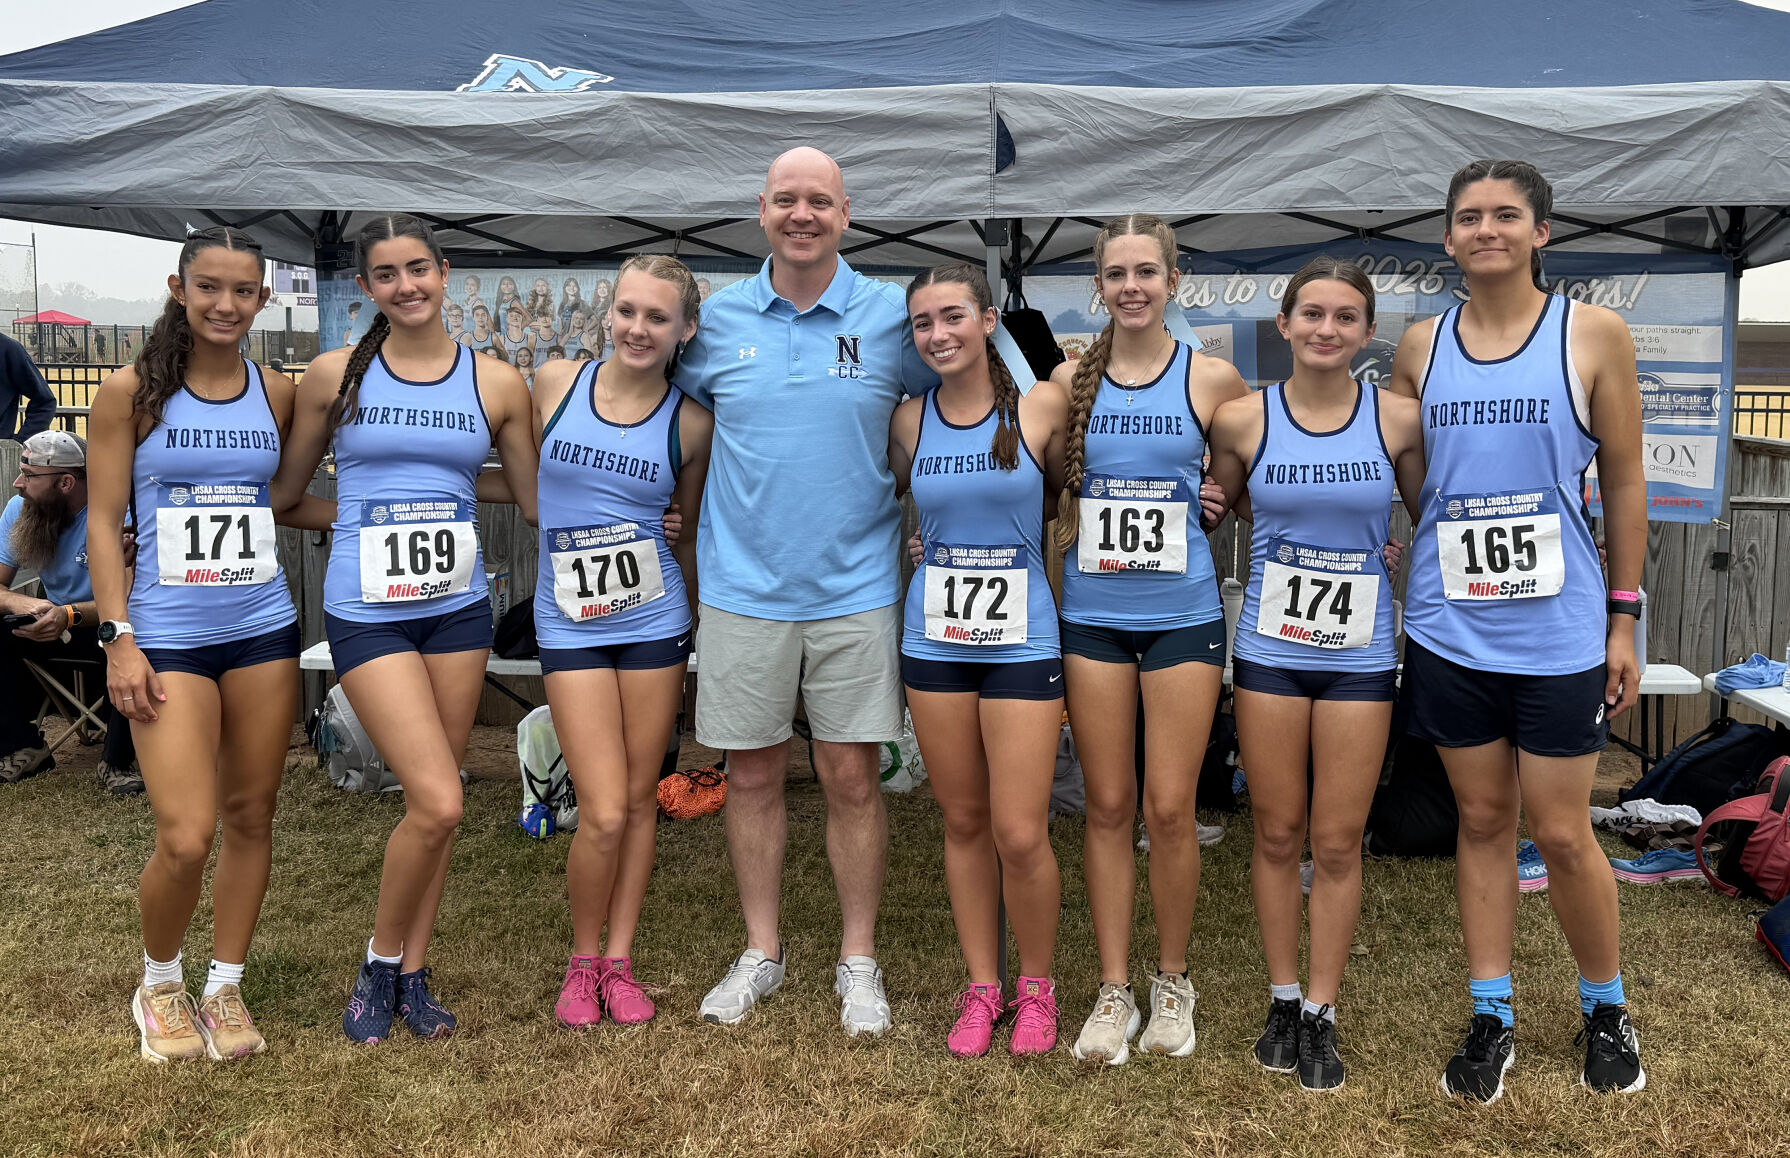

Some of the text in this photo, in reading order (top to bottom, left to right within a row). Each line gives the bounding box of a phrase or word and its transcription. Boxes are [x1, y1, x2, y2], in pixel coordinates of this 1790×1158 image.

[1223, 269, 1257, 305] to
[1646, 326, 1668, 335] paths
[835, 334, 862, 366] N
[1642, 345, 1668, 355] Family
[1672, 393, 1708, 403] Center
[354, 406, 476, 434] NORTHSHORE
[1429, 398, 1550, 430] NORTHSHORE
[165, 428, 278, 452] NORTHSHORE
[550, 439, 660, 483] NORTHSHORE
[1264, 461, 1382, 485] NORTHSHORE
[1649, 464, 1697, 478] aesthetics
[191, 485, 259, 495] LHSAA CROSS COUNTRY
[1106, 478, 1178, 490] LHSAA CROSS COUNTRY
[195, 495, 256, 504] CHAMPIONSHIPS
[1109, 488, 1172, 499] CHAMPIONSHIPS
[1464, 492, 1543, 509] LHSAA CROSS COUNTRY
[389, 502, 458, 513] LHSAA CROSS COUNTRY
[393, 510, 456, 521] CHAMPIONSHIPS
[1468, 502, 1539, 517] CHAMPIONSHIPS
[184, 514, 256, 561] 171
[570, 522, 640, 540] LHSAA CROSS COUNTRY
[1098, 507, 1165, 553] 163
[575, 531, 636, 548] CHAMPIONSHIPS
[384, 528, 456, 577] 169
[949, 548, 1017, 558] LHSAA CROSS COUNTRY
[1296, 547, 1367, 563] LHSAA CROSS COUNTRY
[1460, 524, 1538, 575] 165
[952, 557, 1013, 567] CHAMPIONSHIPS
[1299, 556, 1363, 571] CHAMPIONSHIPS
[184, 567, 255, 584] MileSplit
[571, 550, 641, 599] 170
[386, 580, 452, 599] MileSplit
[1467, 578, 1538, 598] MileSplit
[580, 592, 642, 618] MileSplit
[943, 575, 1009, 621] 172
[1283, 574, 1353, 625] 174
[943, 625, 1004, 644] MileSplit
[1279, 623, 1347, 646] MileSplit
[1524, 864, 1548, 877] HOK
